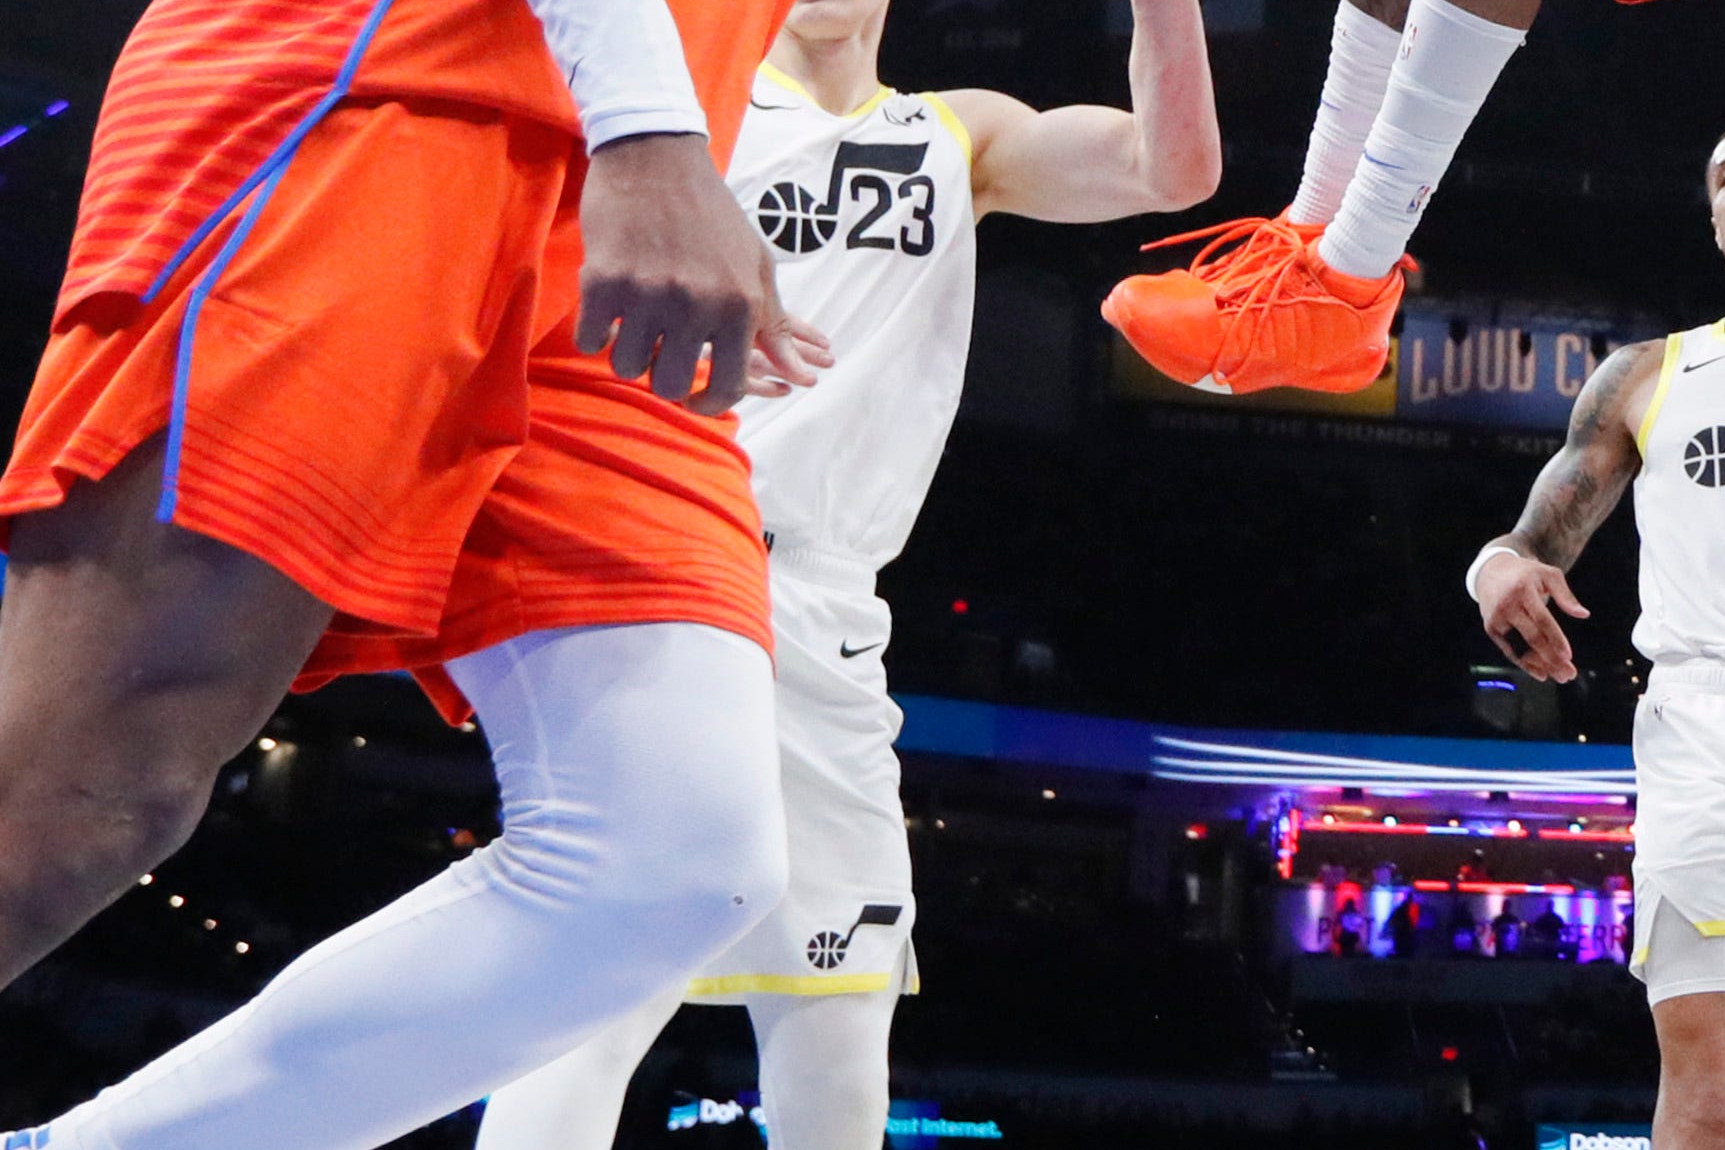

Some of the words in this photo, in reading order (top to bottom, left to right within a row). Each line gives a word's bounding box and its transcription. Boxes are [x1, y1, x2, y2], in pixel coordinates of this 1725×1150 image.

[846, 174, 935, 257] 23
[1411, 328, 1537, 404] LOUD
[1570, 1132, 1651, 1150] Dobson
